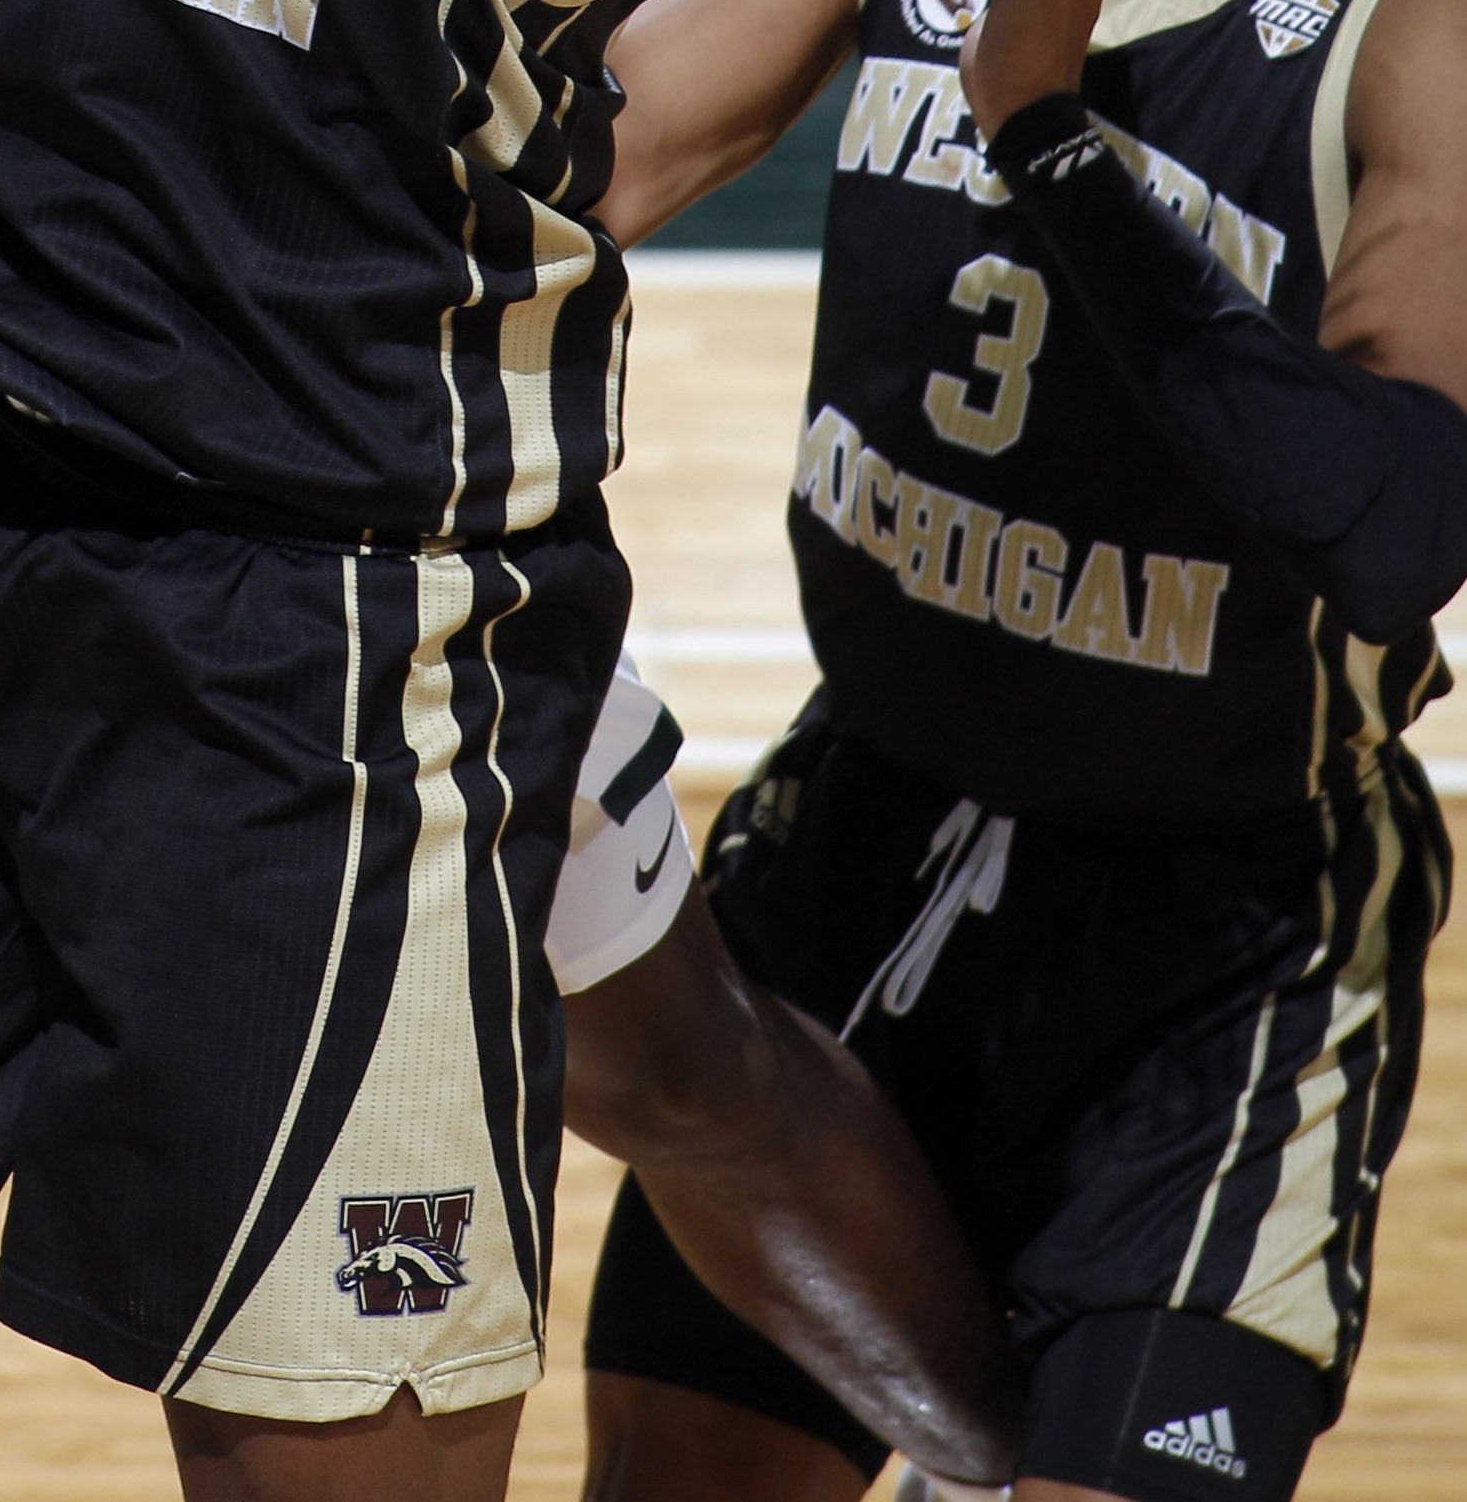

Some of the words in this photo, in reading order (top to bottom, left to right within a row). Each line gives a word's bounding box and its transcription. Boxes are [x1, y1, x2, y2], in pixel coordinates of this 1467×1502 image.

[923, 253, 1049, 457] 3
[791, 404, 1230, 677] MICHIGAN
[1143, 1429, 1246, 1478] adidas
